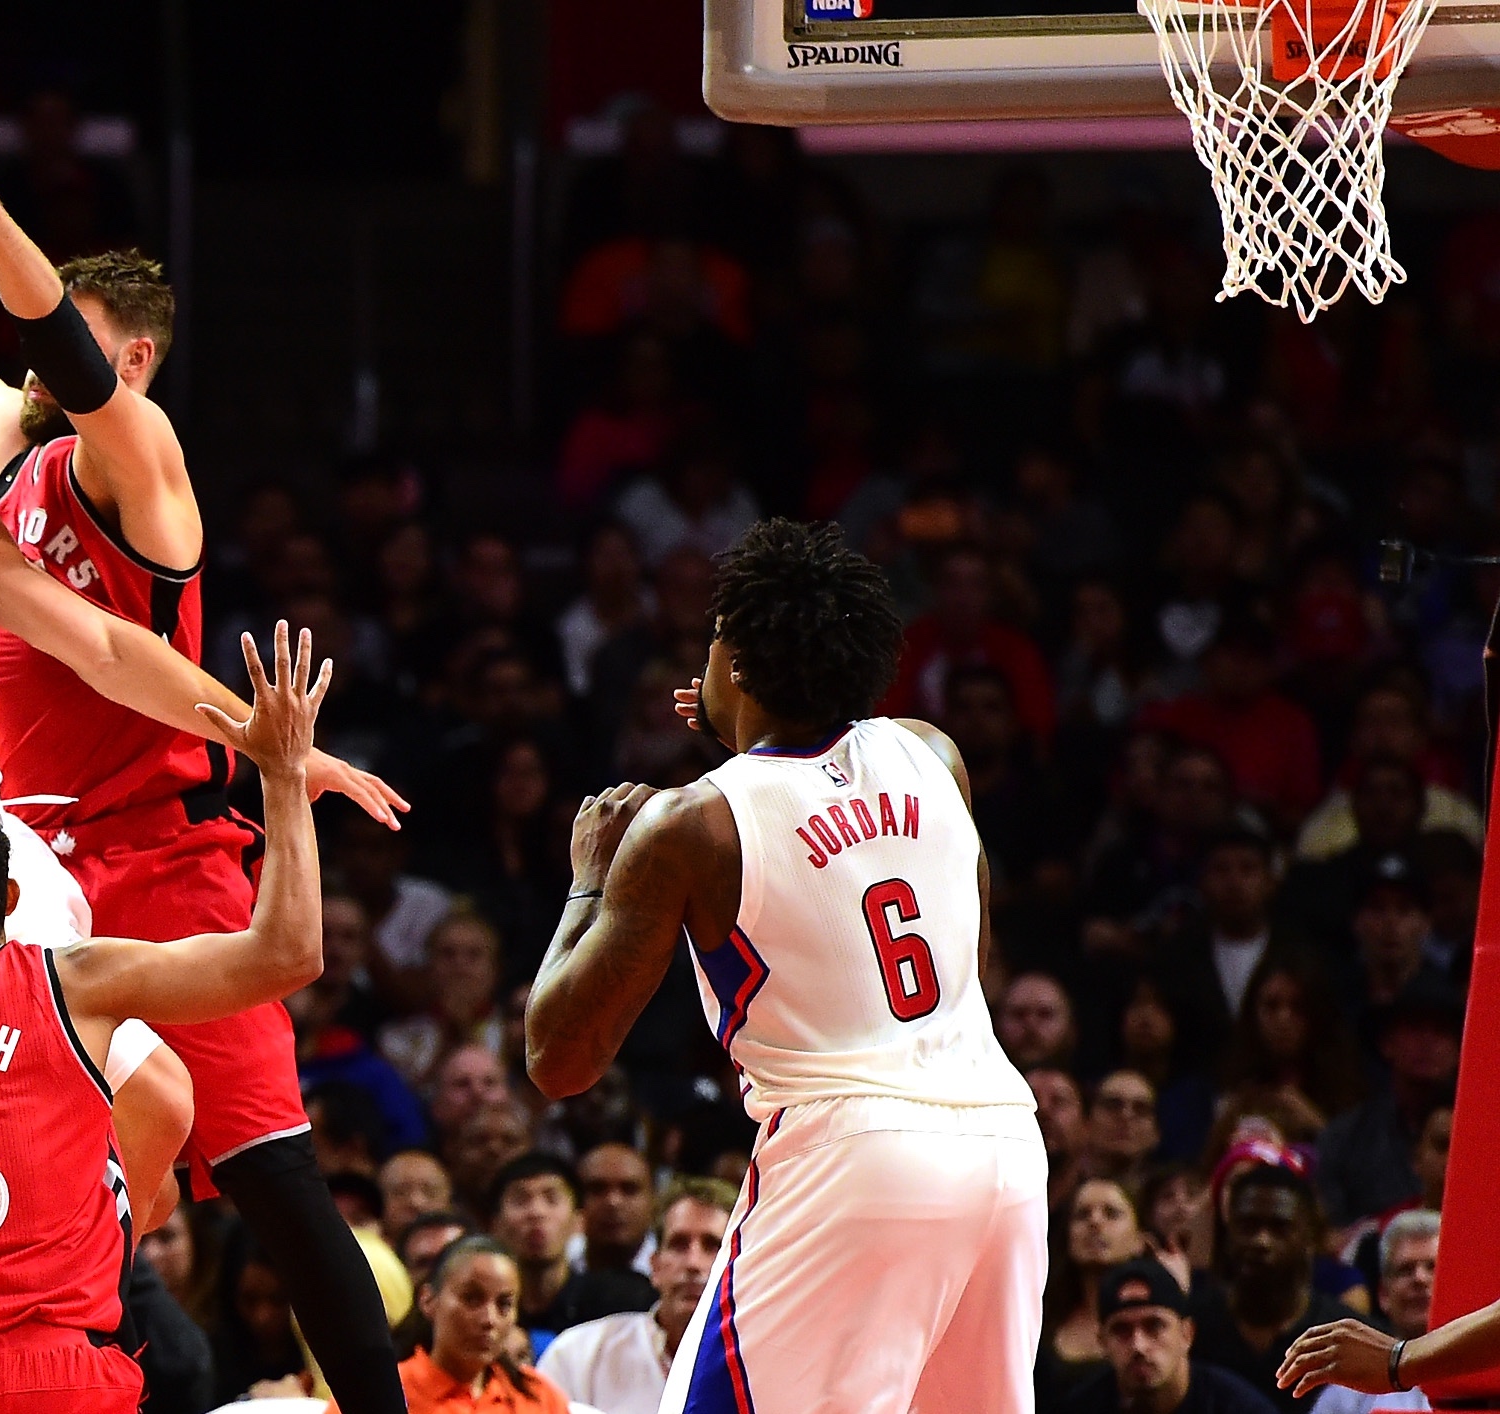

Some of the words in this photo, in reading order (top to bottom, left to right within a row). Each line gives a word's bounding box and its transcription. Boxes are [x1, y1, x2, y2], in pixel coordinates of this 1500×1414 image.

[787, 41, 900, 69] SPALDING
[795, 792, 920, 870] JORDAN
[861, 877, 941, 1023] 6
